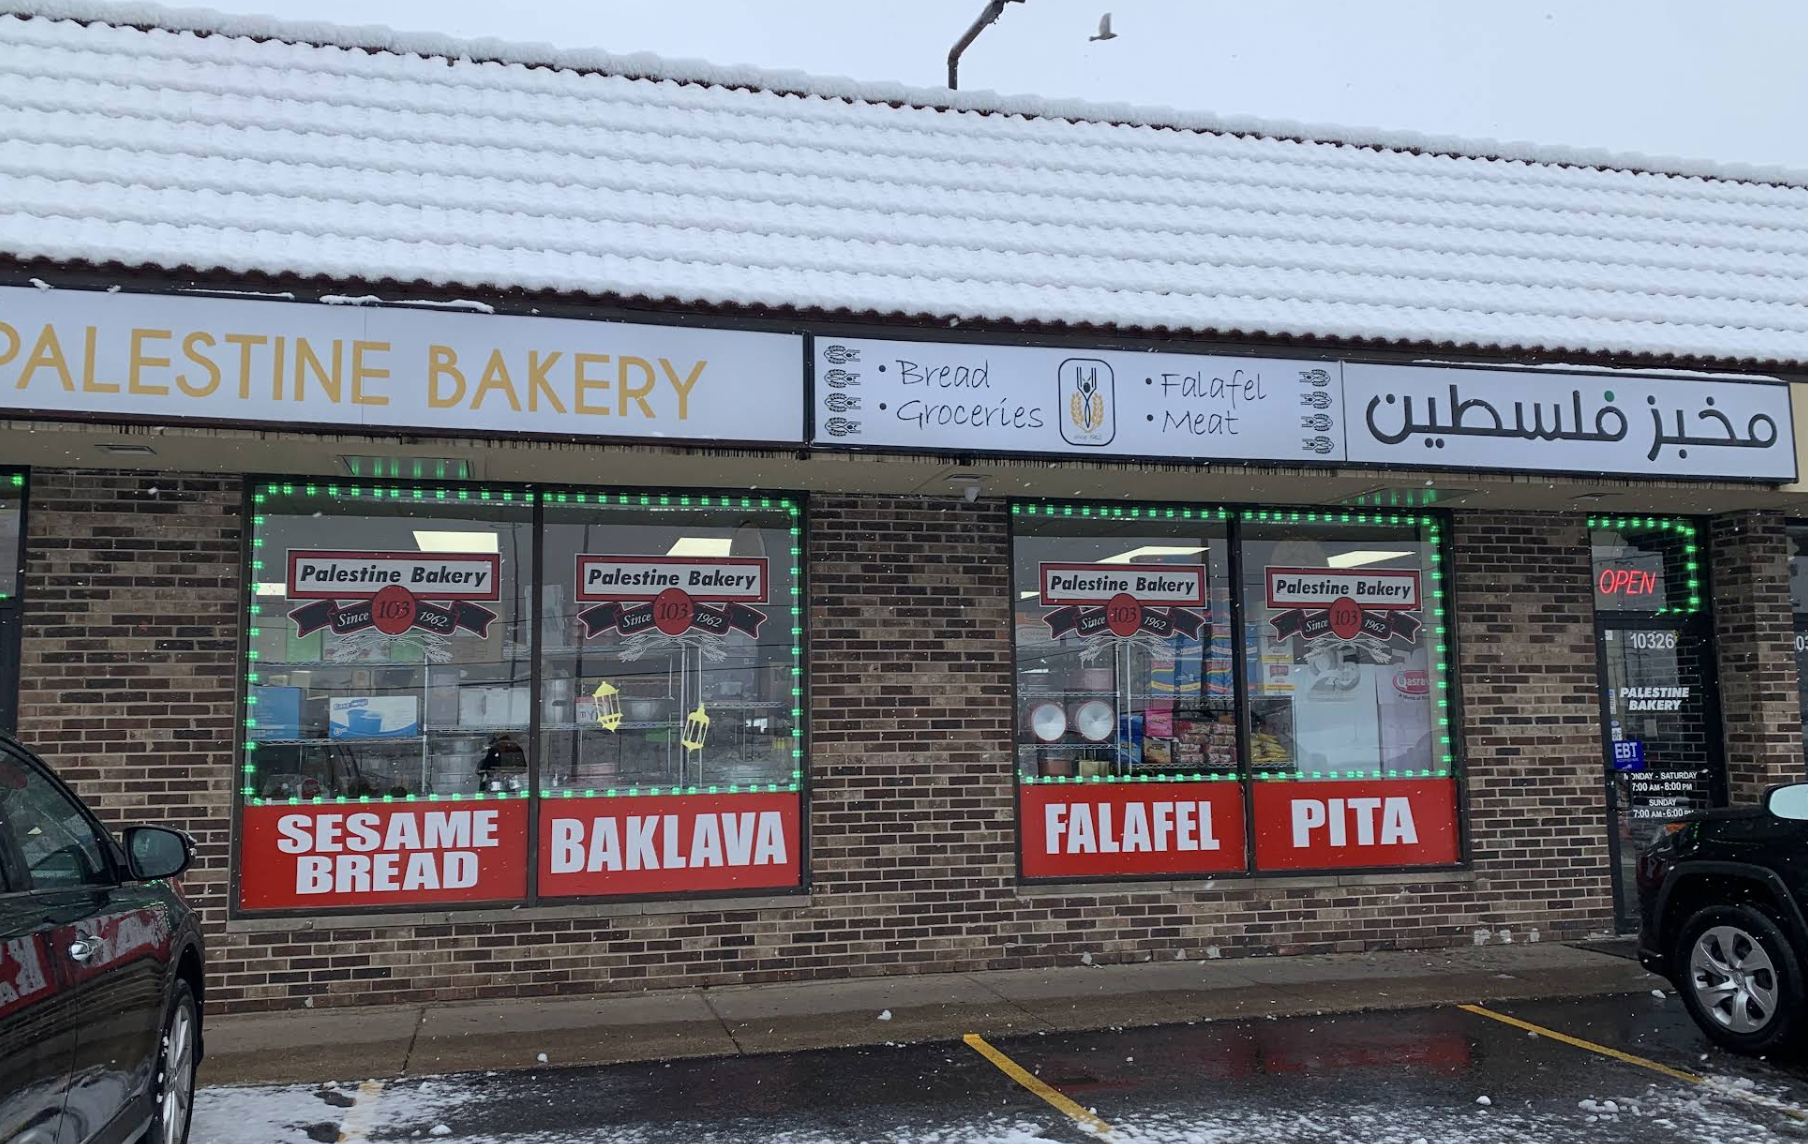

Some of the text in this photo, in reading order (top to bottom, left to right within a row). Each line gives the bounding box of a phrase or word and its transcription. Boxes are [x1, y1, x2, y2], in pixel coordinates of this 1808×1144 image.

[0, 321, 708, 420] PALESTINE BAKERY
[895, 359, 990, 388] Bread
[1160, 369, 1267, 409] Falafel
[896, 397, 1044, 429] Groceries
[1162, 409, 1239, 436] Meat
[1366, 384, 1778, 462] مخبز فلسطين
[300, 563, 488, 587] Palestine Bakery
[588, 568, 757, 590] Palestine Bakery
[1050, 575, 1195, 595] Palestine Bakery
[1599, 569, 1657, 595] OPEN
[1275, 579, 1412, 599] Palestine Bakery
[337, 610, 448, 627] Since 1962
[377, 600, 411, 620] 103
[657, 602, 689, 621] 103
[1110, 605, 1137, 624] 103
[1333, 609, 1358, 626] 103
[622, 612, 723, 629] Since 1962
[1081, 613, 1167, 631] Since 1962
[1305, 617, 1387, 634] Since 1962
[1630, 632, 1676, 649] 10326
[1619, 687, 1690, 698] PALESTINE
[1629, 699, 1682, 711] BAKERY
[1614, 742, 1638, 758] EBT
[1660, 771, 1698, 780] SATURDAY
[1632, 782, 1648, 791] 7:00
[1682, 783, 1693, 791] PM
[1648, 798, 1677, 807] SUNDAY
[1291, 796, 1419, 848] PITA
[1633, 809, 1650, 818] 7:00
[276, 809, 499, 854] SESAME
[1044, 800, 1220, 854] FALAFEL
[549, 811, 788, 875] BAKLAVA
[296, 851, 480, 895] BREAD
